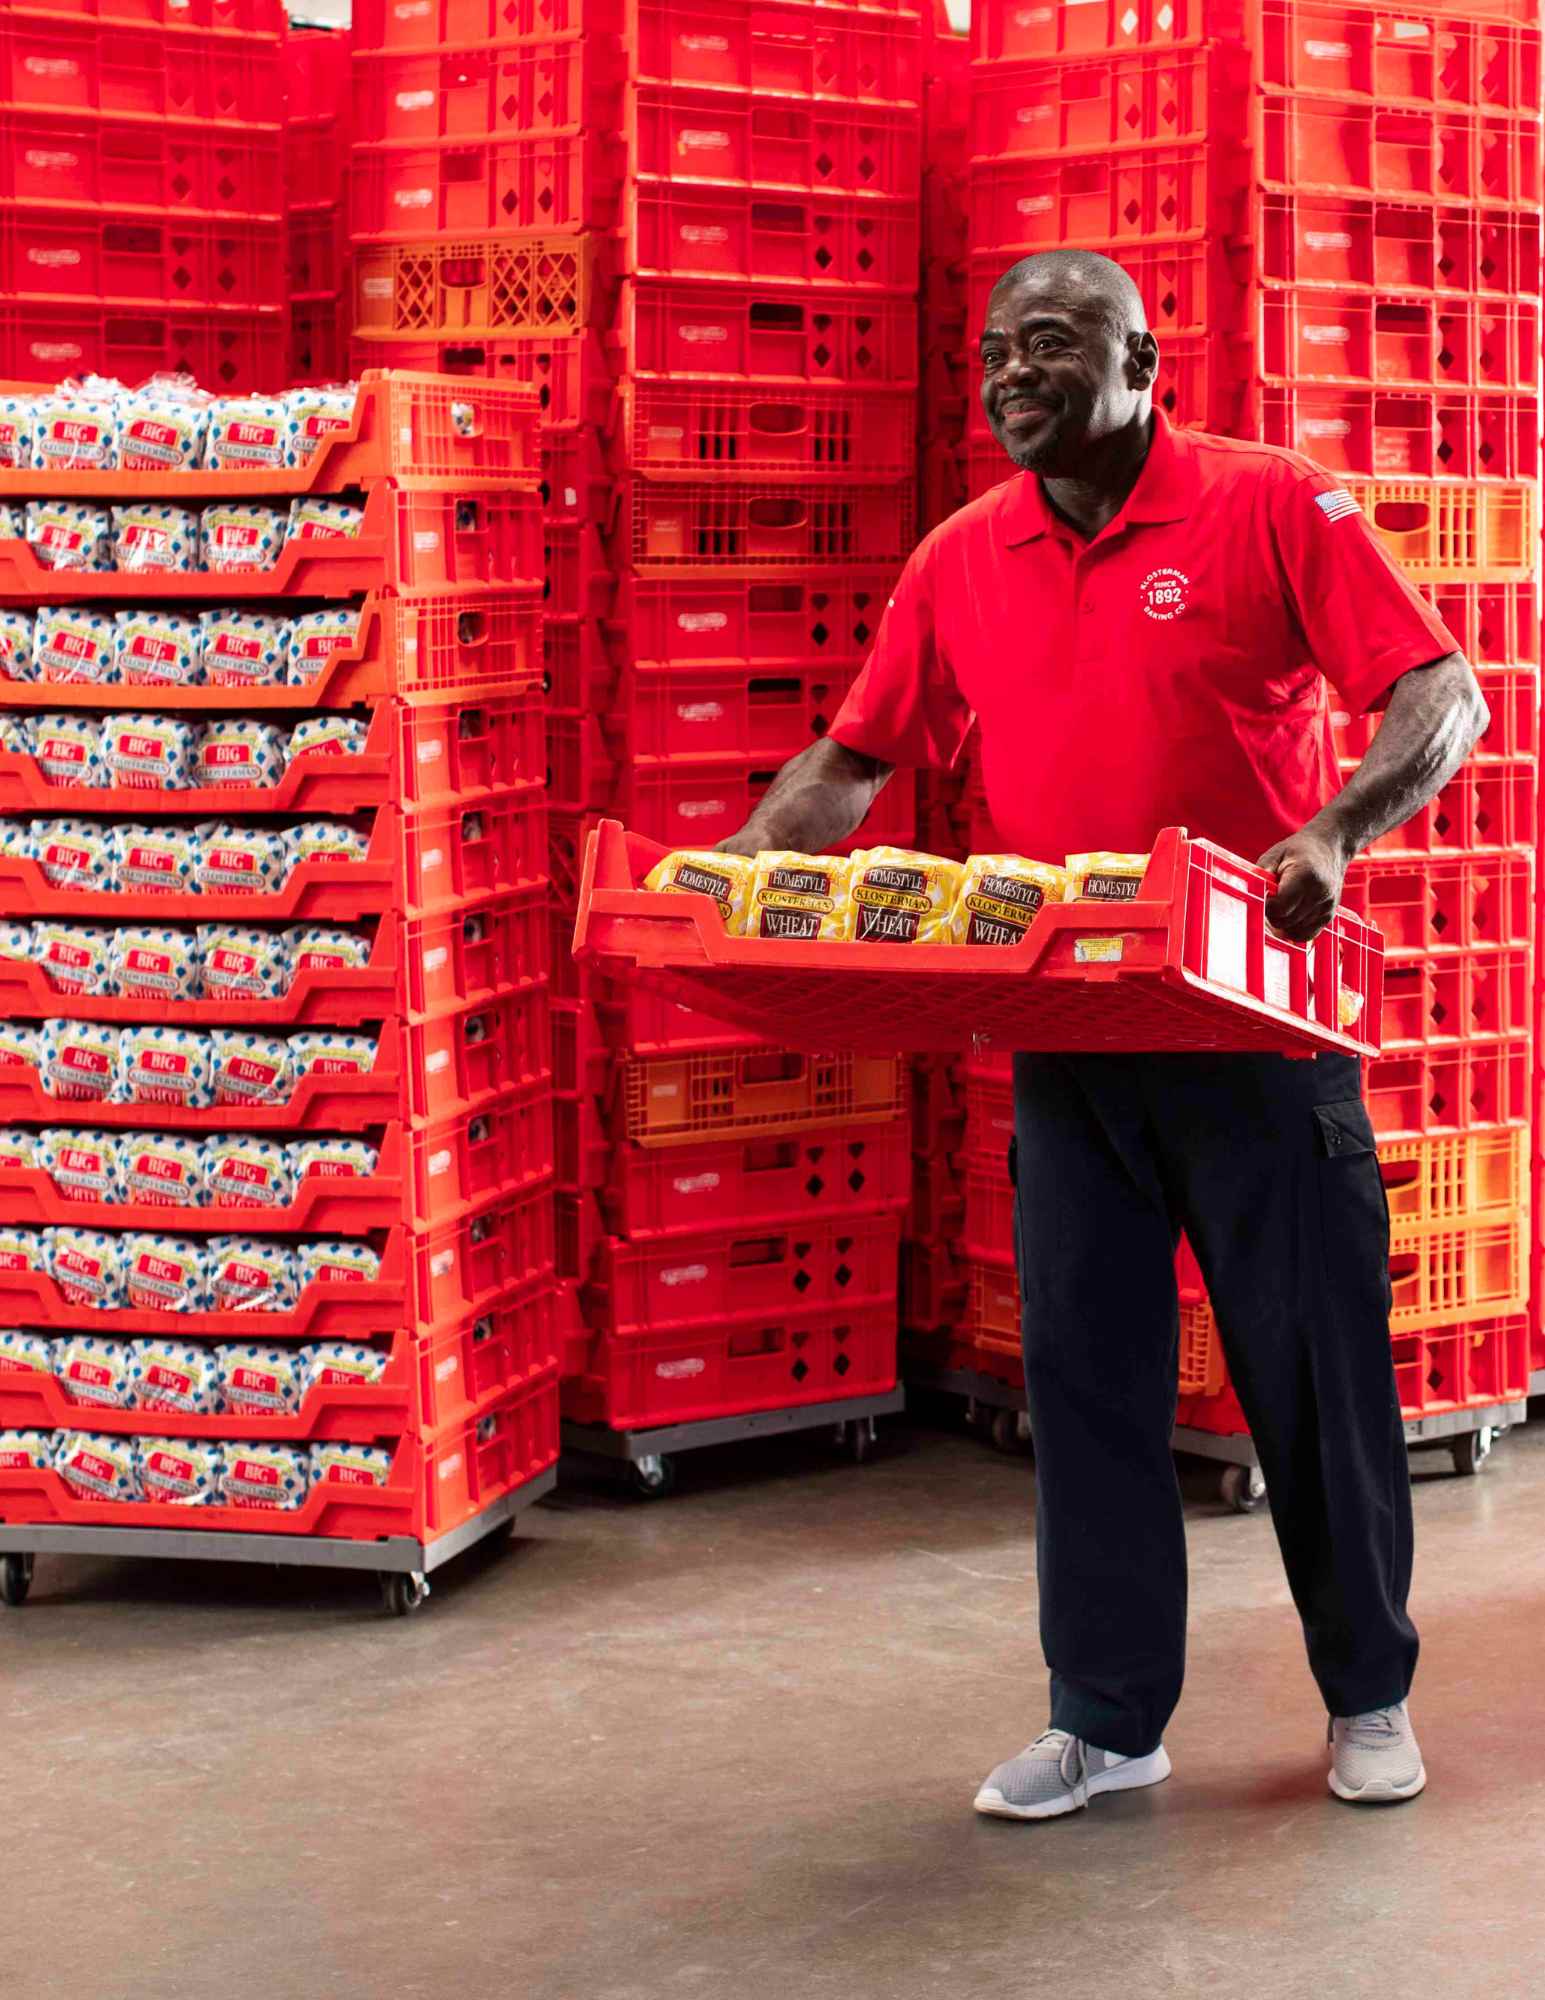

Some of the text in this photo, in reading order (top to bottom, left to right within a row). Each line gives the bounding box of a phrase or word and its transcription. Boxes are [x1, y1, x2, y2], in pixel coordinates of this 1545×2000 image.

[64, 423, 88, 441] BIG
[141, 423, 167, 442] BIG
[239, 424, 264, 442] BIG
[228, 528, 249, 544] BIG
[1139, 567, 1190, 590] KLOSTERMAN
[1153, 580, 1177, 589] SINCE
[1147, 588, 1182, 605] 1892
[64, 636, 85, 656] BIG
[143, 640, 166, 656] BIG
[226, 638, 250, 656] BIG
[206, 655, 265, 673] KLOSTERMAN
[52, 743, 75, 759] BIG
[128, 737, 152, 755] BIG
[216, 747, 240, 762] BIG
[56, 847, 80, 865] BIG
[140, 850, 163, 869] BIG
[220, 852, 243, 868] BIG
[678, 868, 729, 898] HOMESTYLE
[772, 871, 826, 892] HOMESTYLE
[867, 869, 923, 890] HOMESTYLE
[1087, 879, 1141, 897] HOMESTYL
[856, 888, 928, 910] KLOSTERMAN
[983, 875, 1041, 906] HOMESTYLE
[761, 891, 831, 909] KLOSTERMAN
[969, 896, 1034, 924] KLOSTERMA
[765, 912, 818, 937] WHEAT
[862, 910, 914, 938] WHEAT
[59, 945, 81, 965] BIG
[137, 953, 161, 970] BIG
[310, 956, 333, 968] BIG
[74, 1047, 98, 1068] BIG
[151, 1053, 175, 1070] BIG
[240, 1063, 264, 1084] BIG
[324, 1061, 348, 1073] BIG
[132, 1072, 192, 1088] KLOSTERMAN
[69, 1153, 93, 1170] BIG
[148, 1158, 172, 1176] BIG
[320, 1164, 343, 1176] BIG
[233, 1163, 257, 1180] BIG
[67, 1251, 90, 1272] BIG
[147, 1259, 171, 1279] BIG
[235, 1266, 259, 1284] BIG
[330, 1268, 355, 1281] BIG
[79, 1365, 103, 1384] BIG
[158, 1369, 180, 1390] BIG
[243, 1372, 267, 1389] BIG
[81, 1455, 104, 1476] BIG
[159, 1456, 183, 1474] BIG
[245, 1463, 268, 1480] BIG
[339, 1469, 363, 1485] BIG
